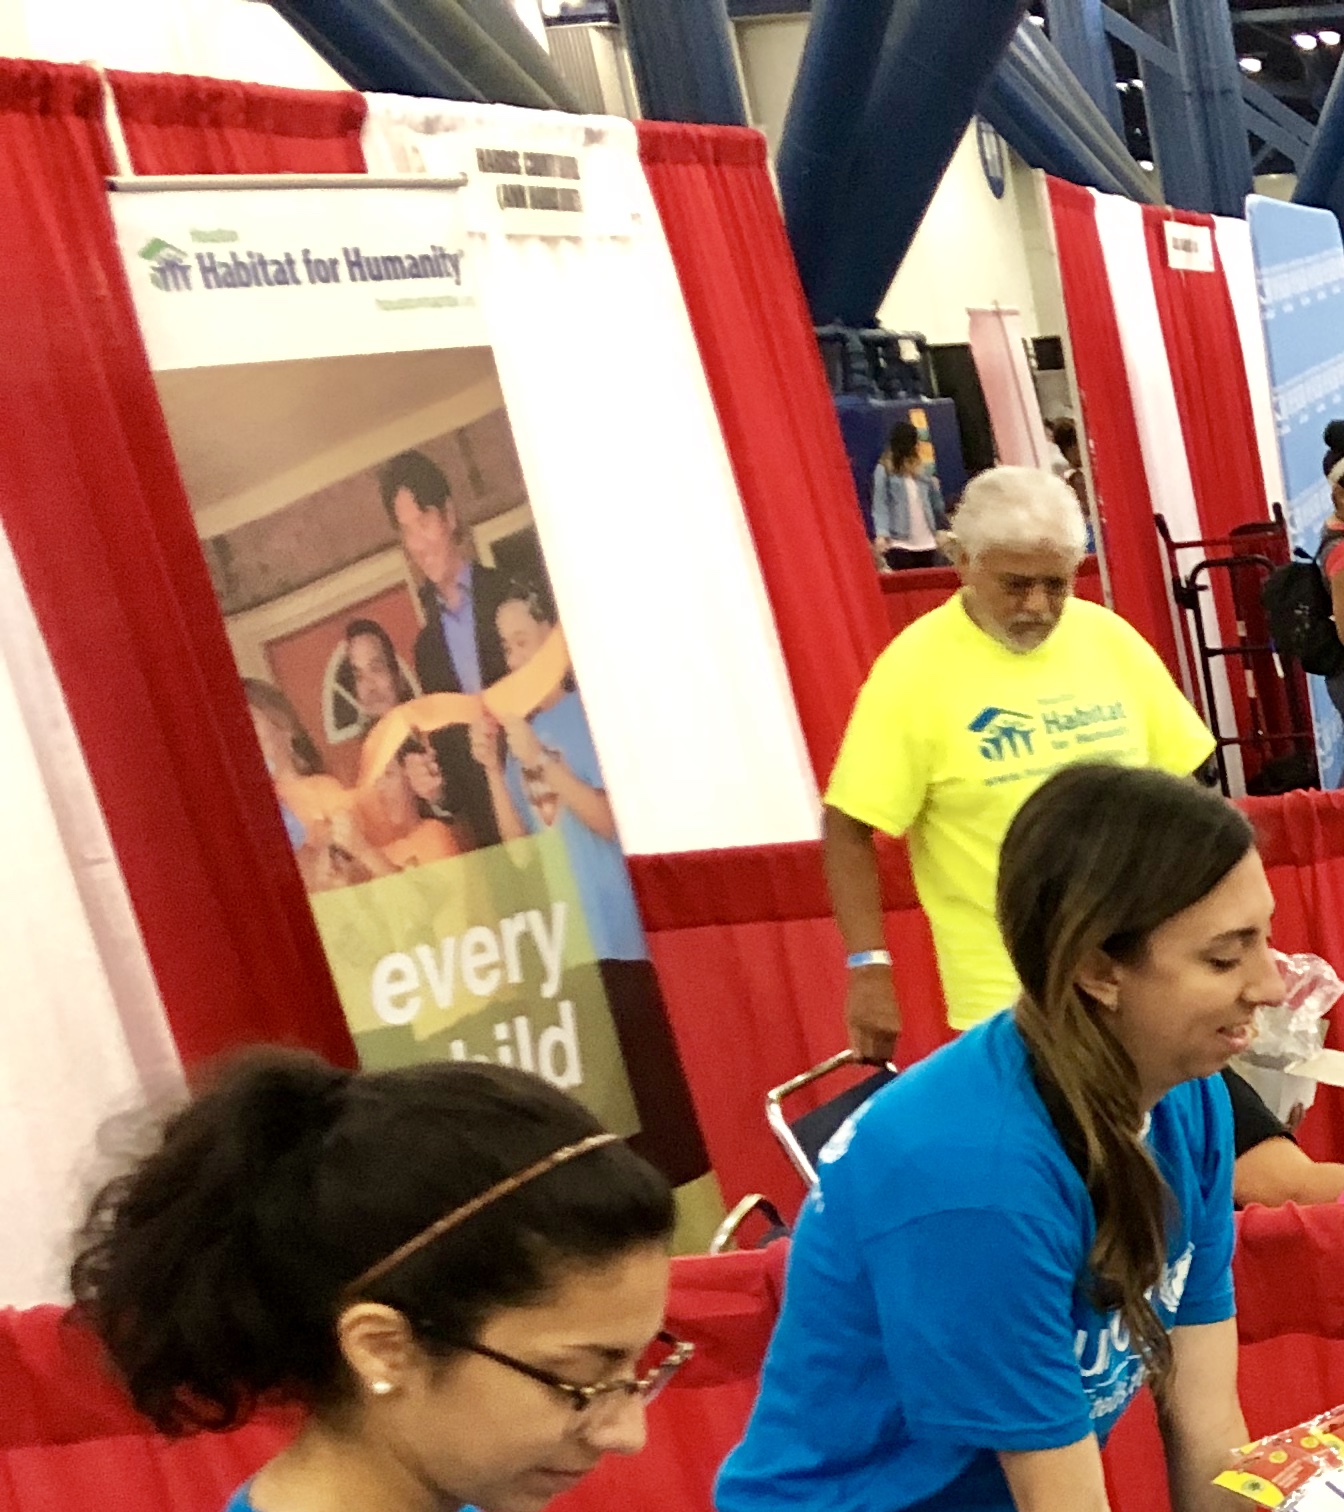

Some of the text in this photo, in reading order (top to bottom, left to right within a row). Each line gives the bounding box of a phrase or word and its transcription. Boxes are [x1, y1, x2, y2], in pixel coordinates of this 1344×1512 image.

[195, 245, 463, 289] Habitat for Humanity
[1041, 701, 1126, 734] Habitat
[371, 901, 567, 1026] every
